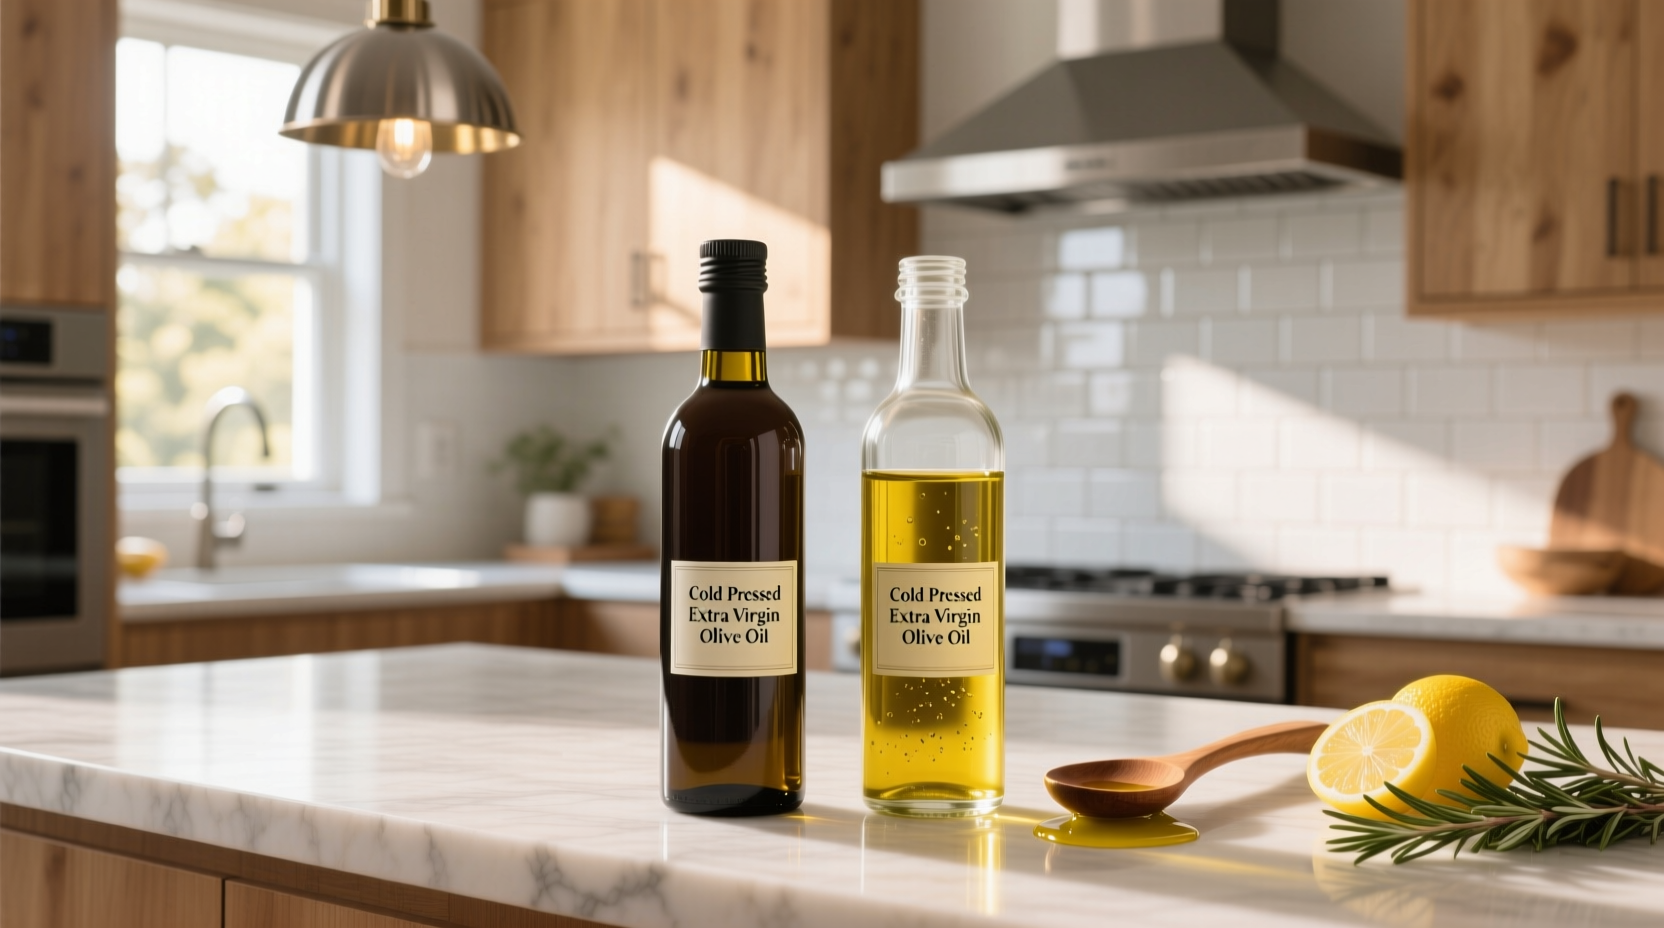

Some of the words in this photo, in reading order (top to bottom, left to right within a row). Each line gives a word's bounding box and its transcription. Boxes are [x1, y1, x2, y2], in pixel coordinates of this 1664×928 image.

[688, 585, 722, 601] Cold
[889, 586, 924, 602] Cold
[929, 586, 982, 602] Pressed
[688, 606, 729, 623] Extra
[732, 606, 780, 627] Virgin
[889, 607, 931, 624] Extra
[934, 607, 981, 628] Virgin
[699, 627, 741, 644] Olive
[745, 627, 769, 644] Oil
[901, 628, 943, 645] Olive
[947, 628, 970, 645] Oil
